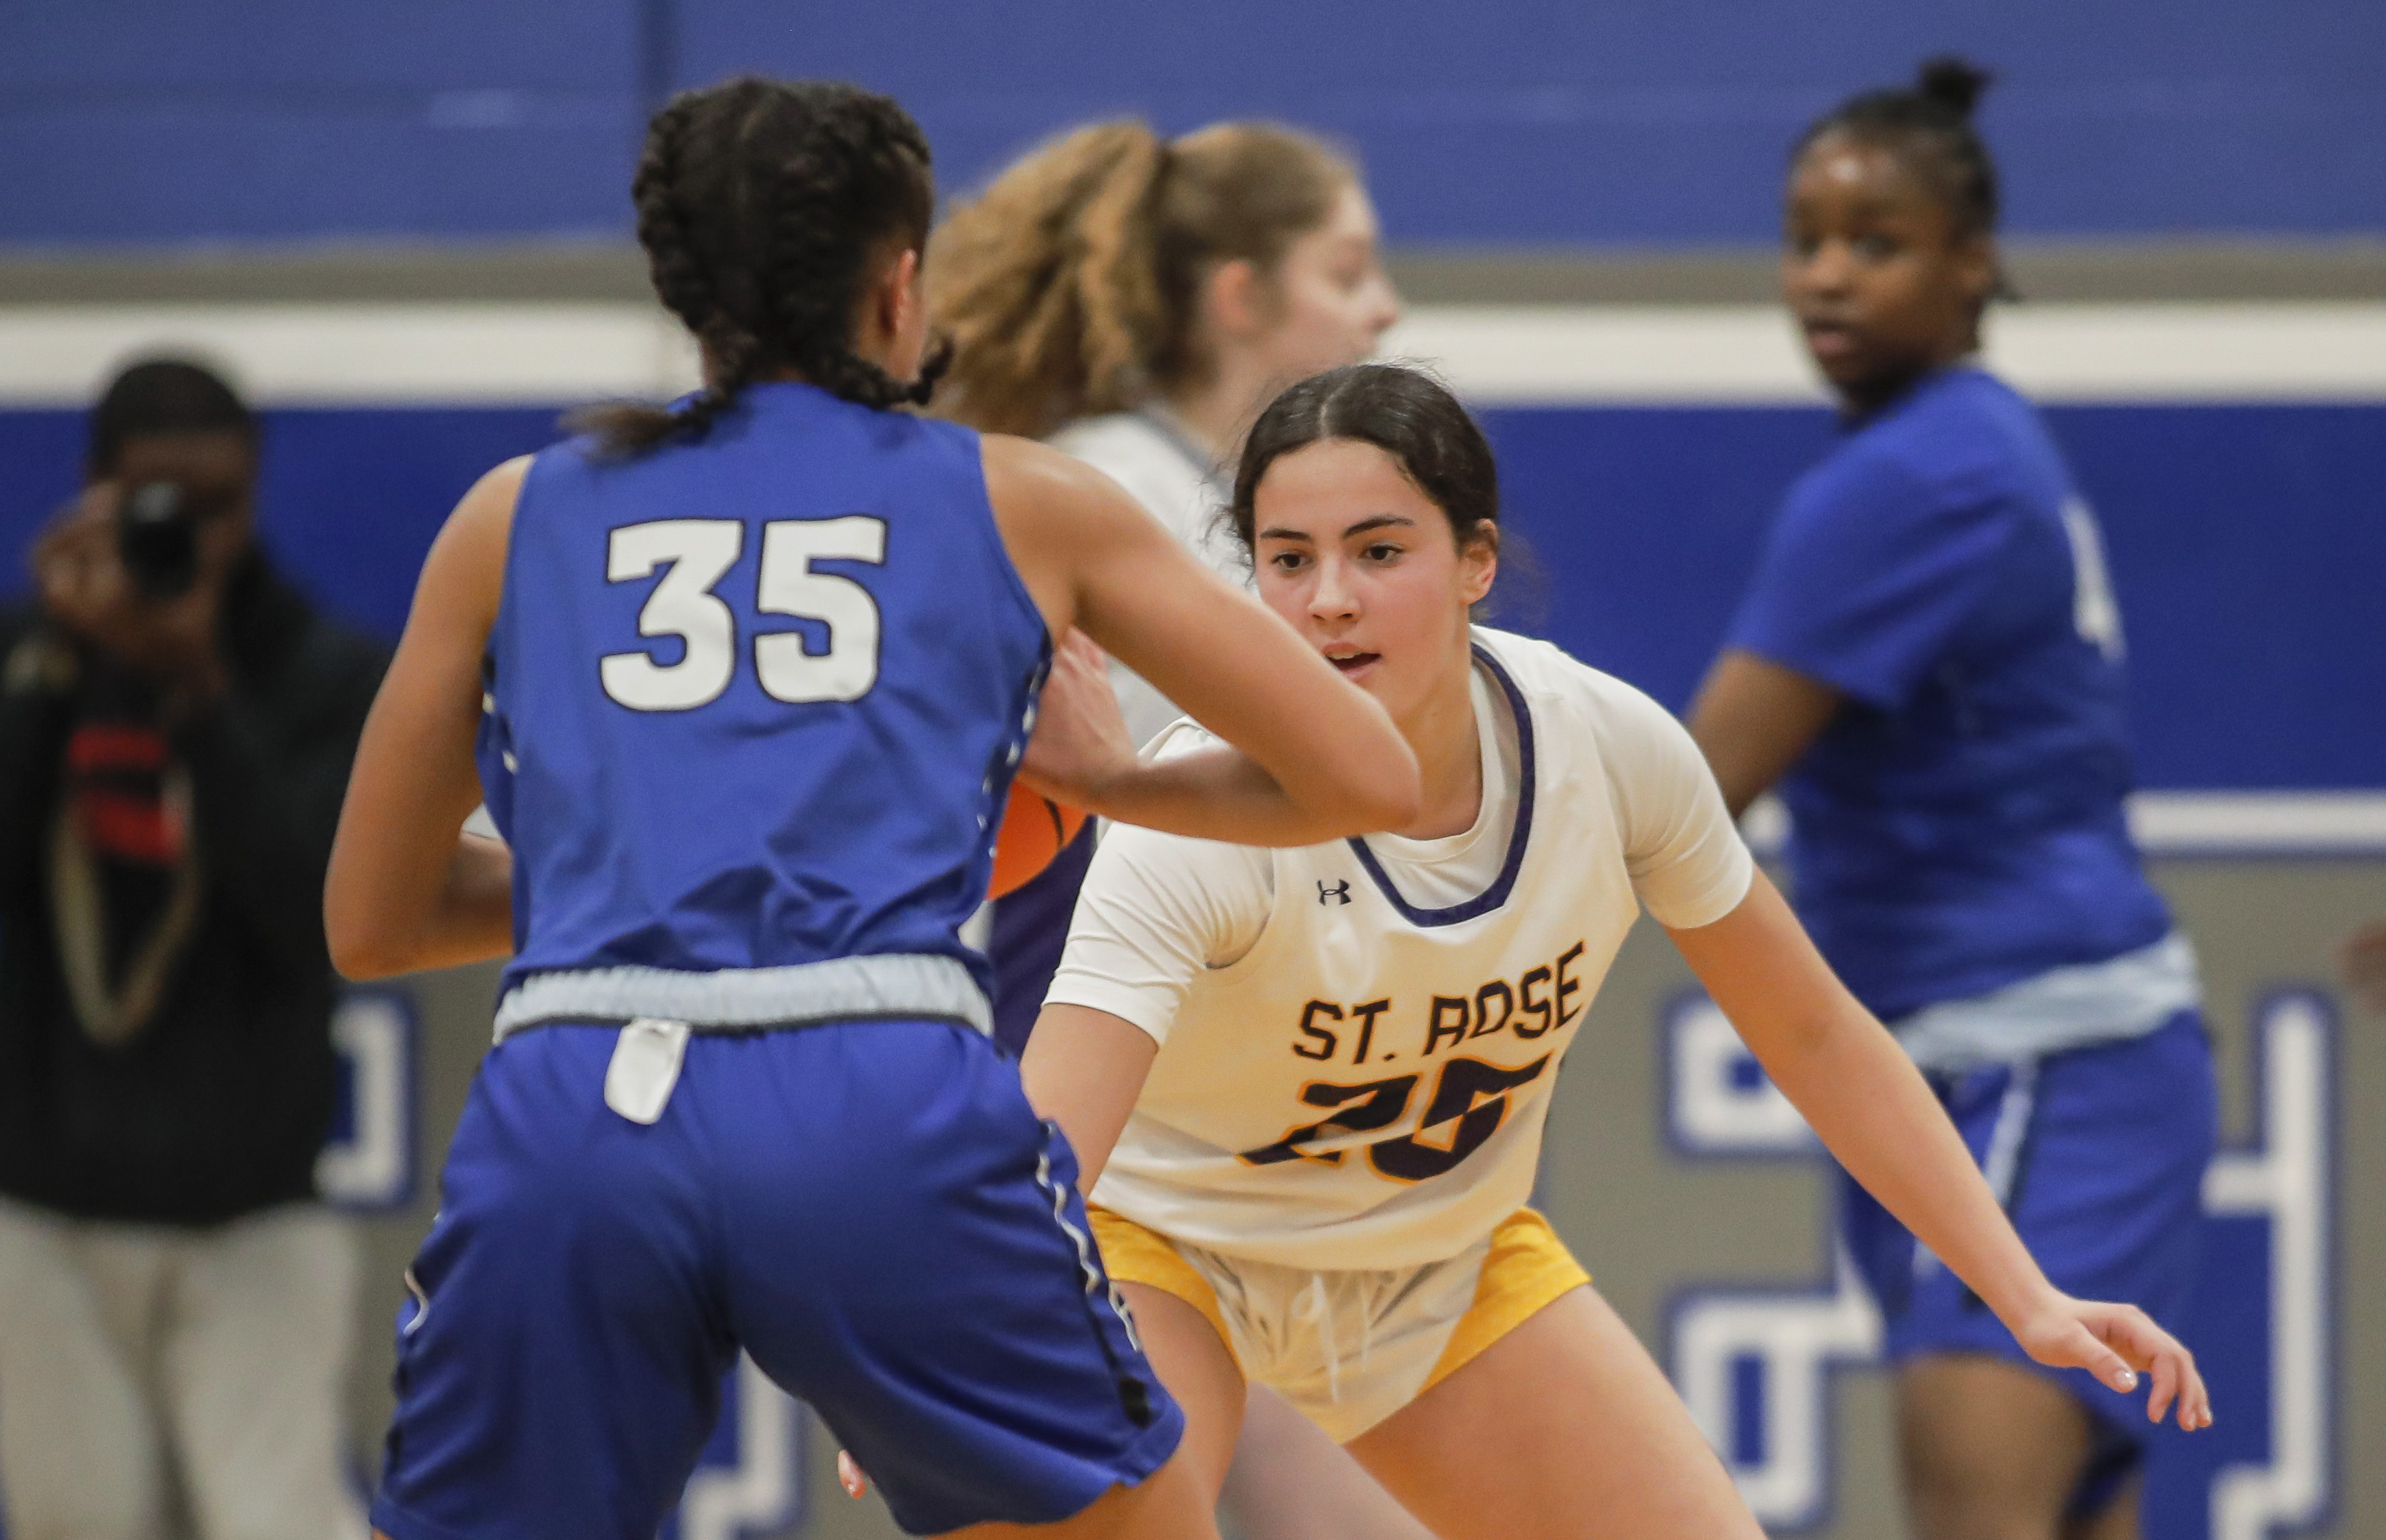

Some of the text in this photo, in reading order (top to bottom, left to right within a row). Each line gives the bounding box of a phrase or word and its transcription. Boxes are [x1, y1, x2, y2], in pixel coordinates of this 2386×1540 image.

[600, 515, 887, 712] 35
[1292, 938, 1586, 1065] ST. ROSE
[1236, 1048, 1554, 1183] 25
